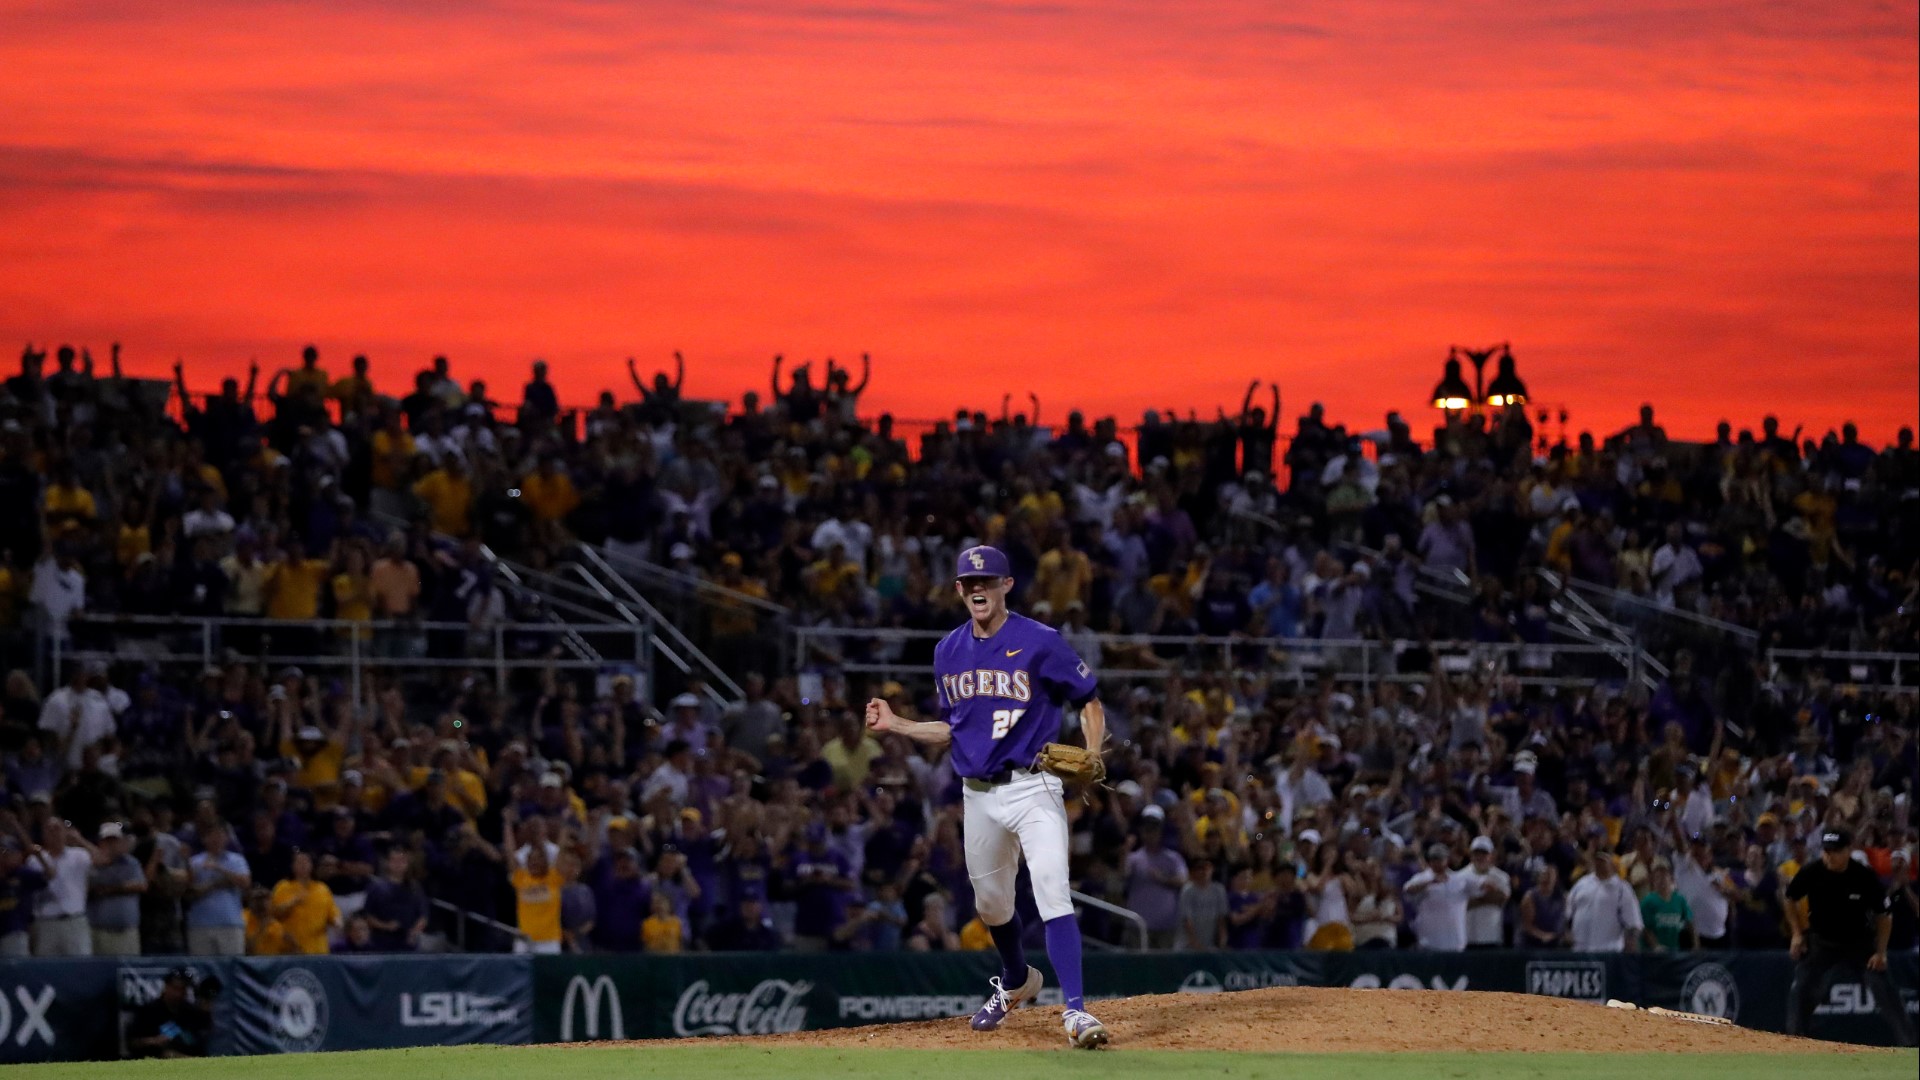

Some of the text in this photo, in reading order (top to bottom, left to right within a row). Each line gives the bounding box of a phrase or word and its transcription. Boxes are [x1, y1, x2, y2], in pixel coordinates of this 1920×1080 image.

[968, 550, 985, 570] LSU
[942, 669, 1031, 707] TIGERS
[1532, 970, 1601, 997] PEOPLES
[400, 991, 467, 1027] LSU
